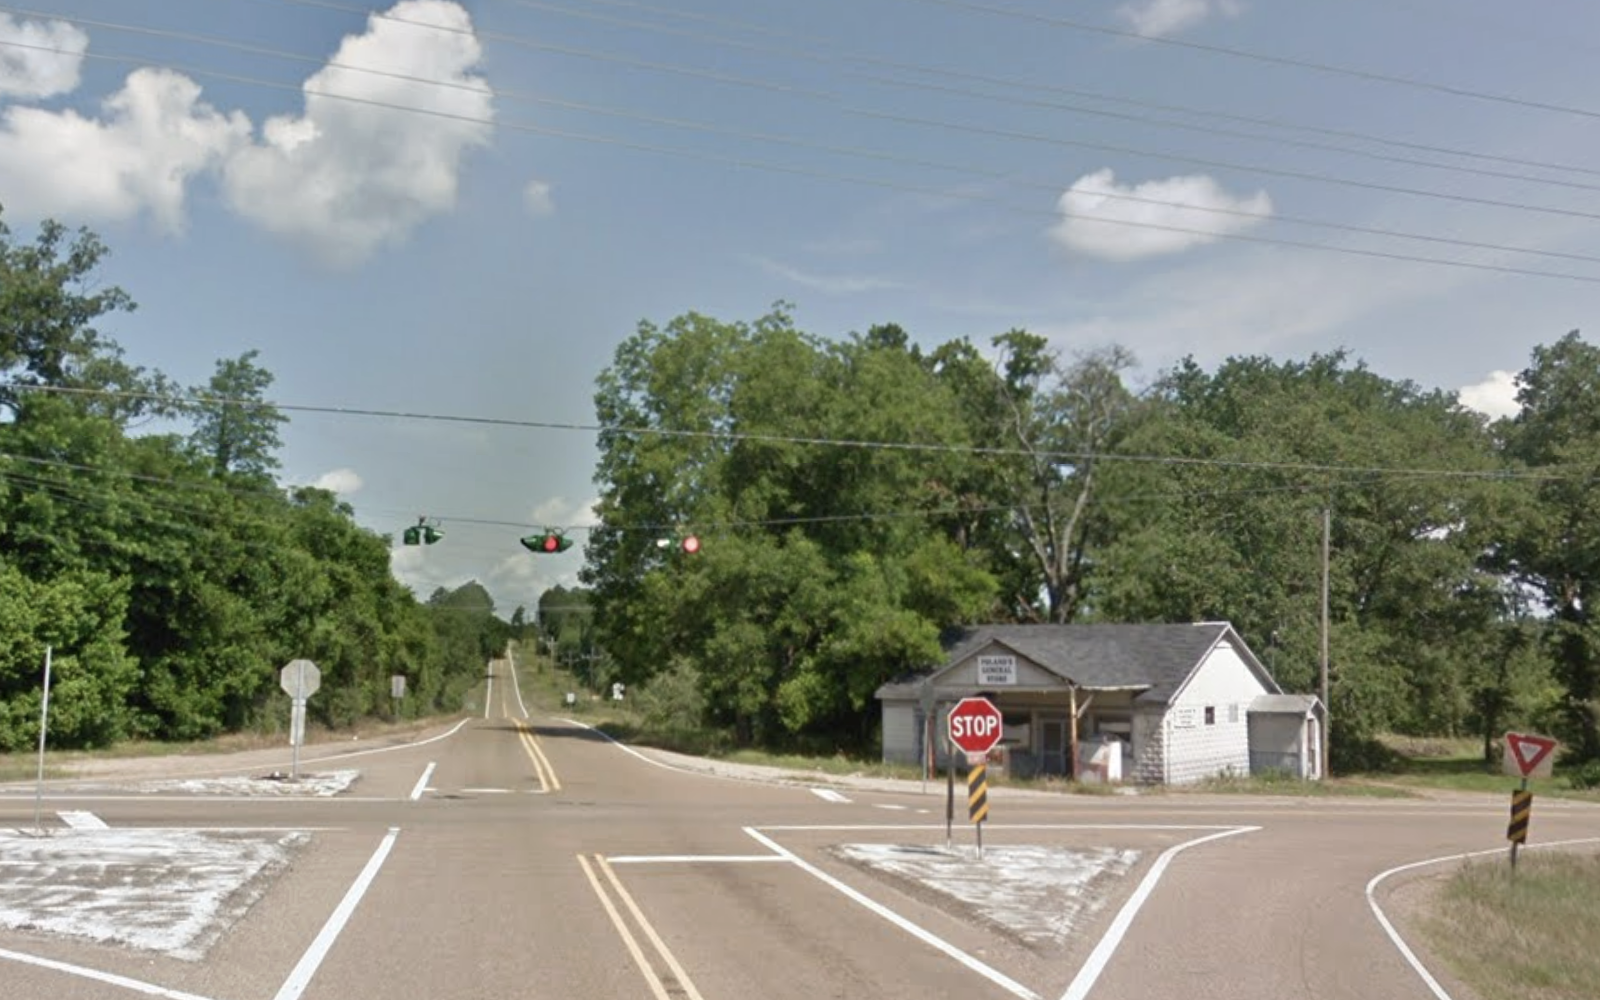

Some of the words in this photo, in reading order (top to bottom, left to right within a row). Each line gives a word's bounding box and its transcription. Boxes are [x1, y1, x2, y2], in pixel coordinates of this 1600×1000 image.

[982, 666, 1012, 674] GENERAL
[987, 675, 1007, 683] STORE
[953, 715, 997, 737] STOP
